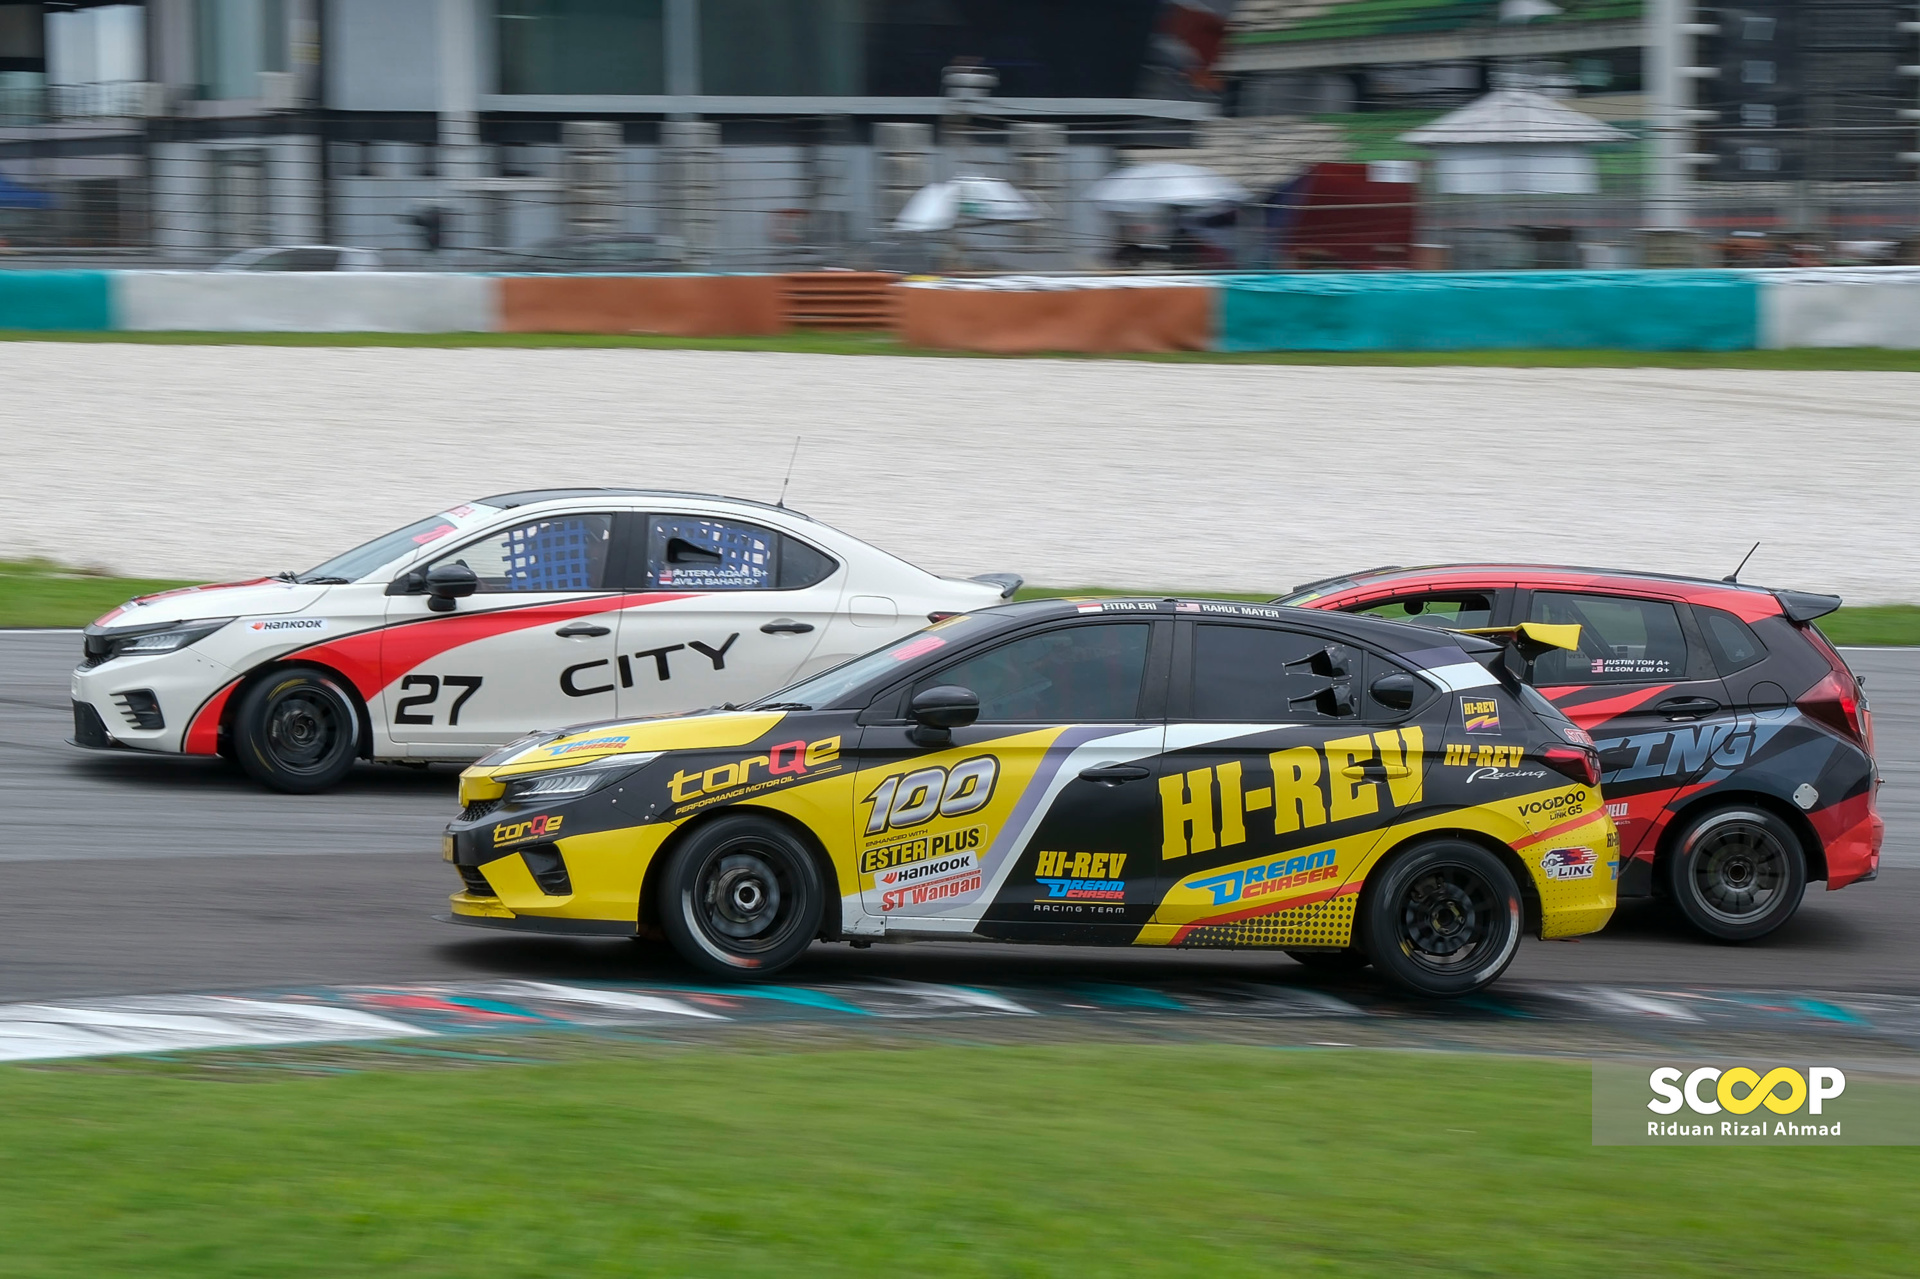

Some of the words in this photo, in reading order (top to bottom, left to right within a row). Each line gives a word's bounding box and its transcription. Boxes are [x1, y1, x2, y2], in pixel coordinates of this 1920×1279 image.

[671, 577, 703, 586] AVILA
[704, 577, 742, 586] BAHAR
[1103, 602, 1137, 611] FITRA
[1138, 602, 1157, 611] ERI
[1202, 604, 1240, 615] RAHUL
[1241, 607, 1280, 618] MAYER
[559, 632, 741, 698] CITY
[394, 674, 484, 726] 27
[1463, 701, 1495, 715] HI-REV
[544, 736, 631, 757] DREAM
[567, 742, 628, 753] CHASER
[1443, 743, 1524, 769] HI-REV
[1465, 767, 1548, 784] Racing
[675, 787, 745, 816] PERFORMANCE
[745, 778, 780, 794] MOTOR
[780, 775, 795, 785] OIL
[860, 753, 1001, 838] 100
[1158, 725, 1424, 861] HI-REV
[1517, 791, 1586, 817] VOODOO
[1549, 811, 1567, 821] LINK
[1567, 804, 1583, 816] G5
[865, 834, 908, 848] ENHANCED
[908, 829, 929, 838] WITH
[865, 839, 926, 872] ESTER
[932, 828, 980, 856] PLUS
[1034, 851, 1128, 879] HI-REV
[1558, 865, 1593, 877] LINK
[1035, 878, 1126, 898] DREAM
[1184, 848, 1337, 907] DREAM
[1241, 864, 1339, 900] CHASER
[881, 887, 907, 912] ST
[911, 876, 982, 905] Wangan
[1066, 889, 1125, 900] CHASER
[1033, 904, 1083, 913] RACING
[1090, 906, 1125, 914] TEAM
